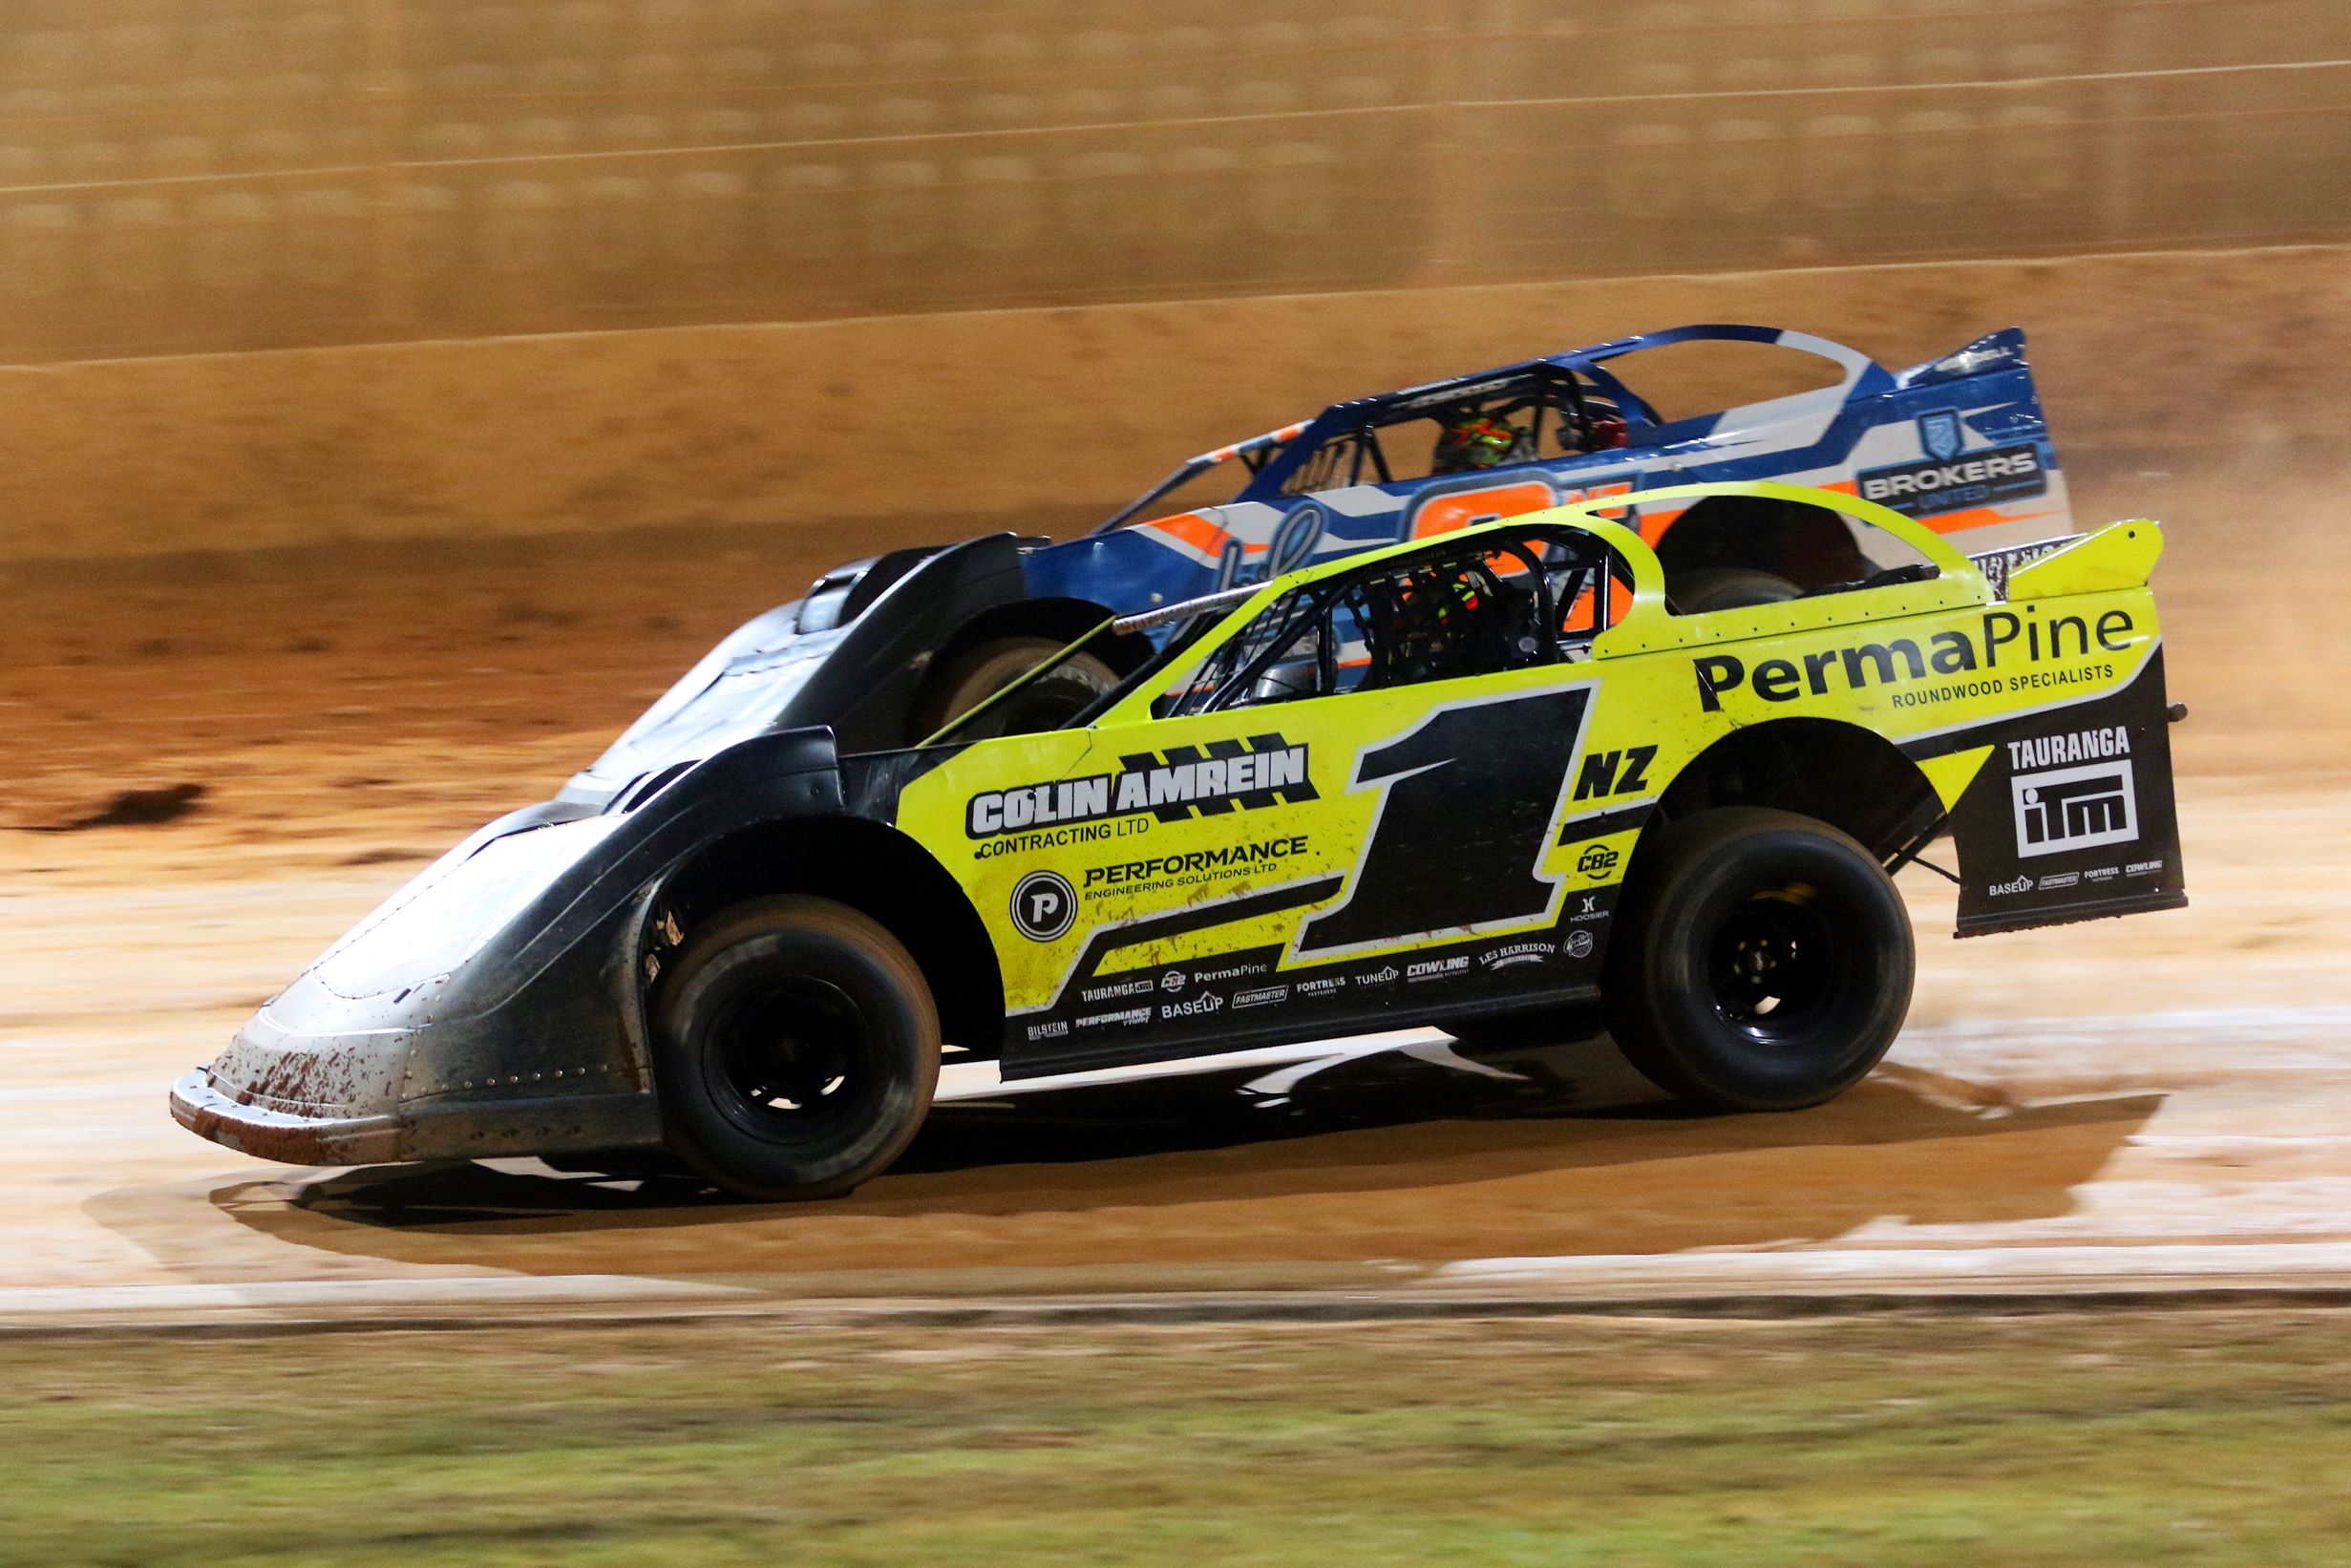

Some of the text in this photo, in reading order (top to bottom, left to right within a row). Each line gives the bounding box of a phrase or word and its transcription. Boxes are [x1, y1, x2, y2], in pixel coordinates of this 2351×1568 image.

[1864, 453, 2038, 500] BROKERS
[1693, 604, 2133, 712] PermaPine
[1893, 664, 2114, 709] ROUNDWOOD SPECIALISTS
[2007, 726, 2130, 771] TAURANGA
[1573, 744, 1659, 801] NZ
[971, 747, 1304, 836] COLIN AMREIN
[1294, 682, 1598, 957] 1
[980, 817, 1149, 859] CONTRACTING LTD
[1083, 835, 1308, 888] PERFORMANCE
[1578, 851, 1620, 873] CB2
[2084, 866, 2120, 879] FORTRESS
[1085, 862, 1278, 901] ENGINEERING SOLUTIONS LTD
[1029, 891, 1059, 923] P
[1570, 910, 1609, 923] HOOSIER
[1407, 955, 1470, 977] COWLING
[1479, 949, 1498, 965] LES
[1499, 943, 1557, 958] HARRISON
[1195, 961, 1268, 984] PermaPine
[1297, 975, 1346, 992] FORTRESS
[1354, 967, 1400, 985] TUNEUP
[1081, 983, 1136, 1003] TAURANGA
[1235, 989, 1286, 1006] FASTMASTER
[1075, 1006, 1153, 1028] PERFORMANCE
[1161, 995, 1224, 1020] BASEUP
[1027, 1020, 1069, 1036] BILSTEIN
